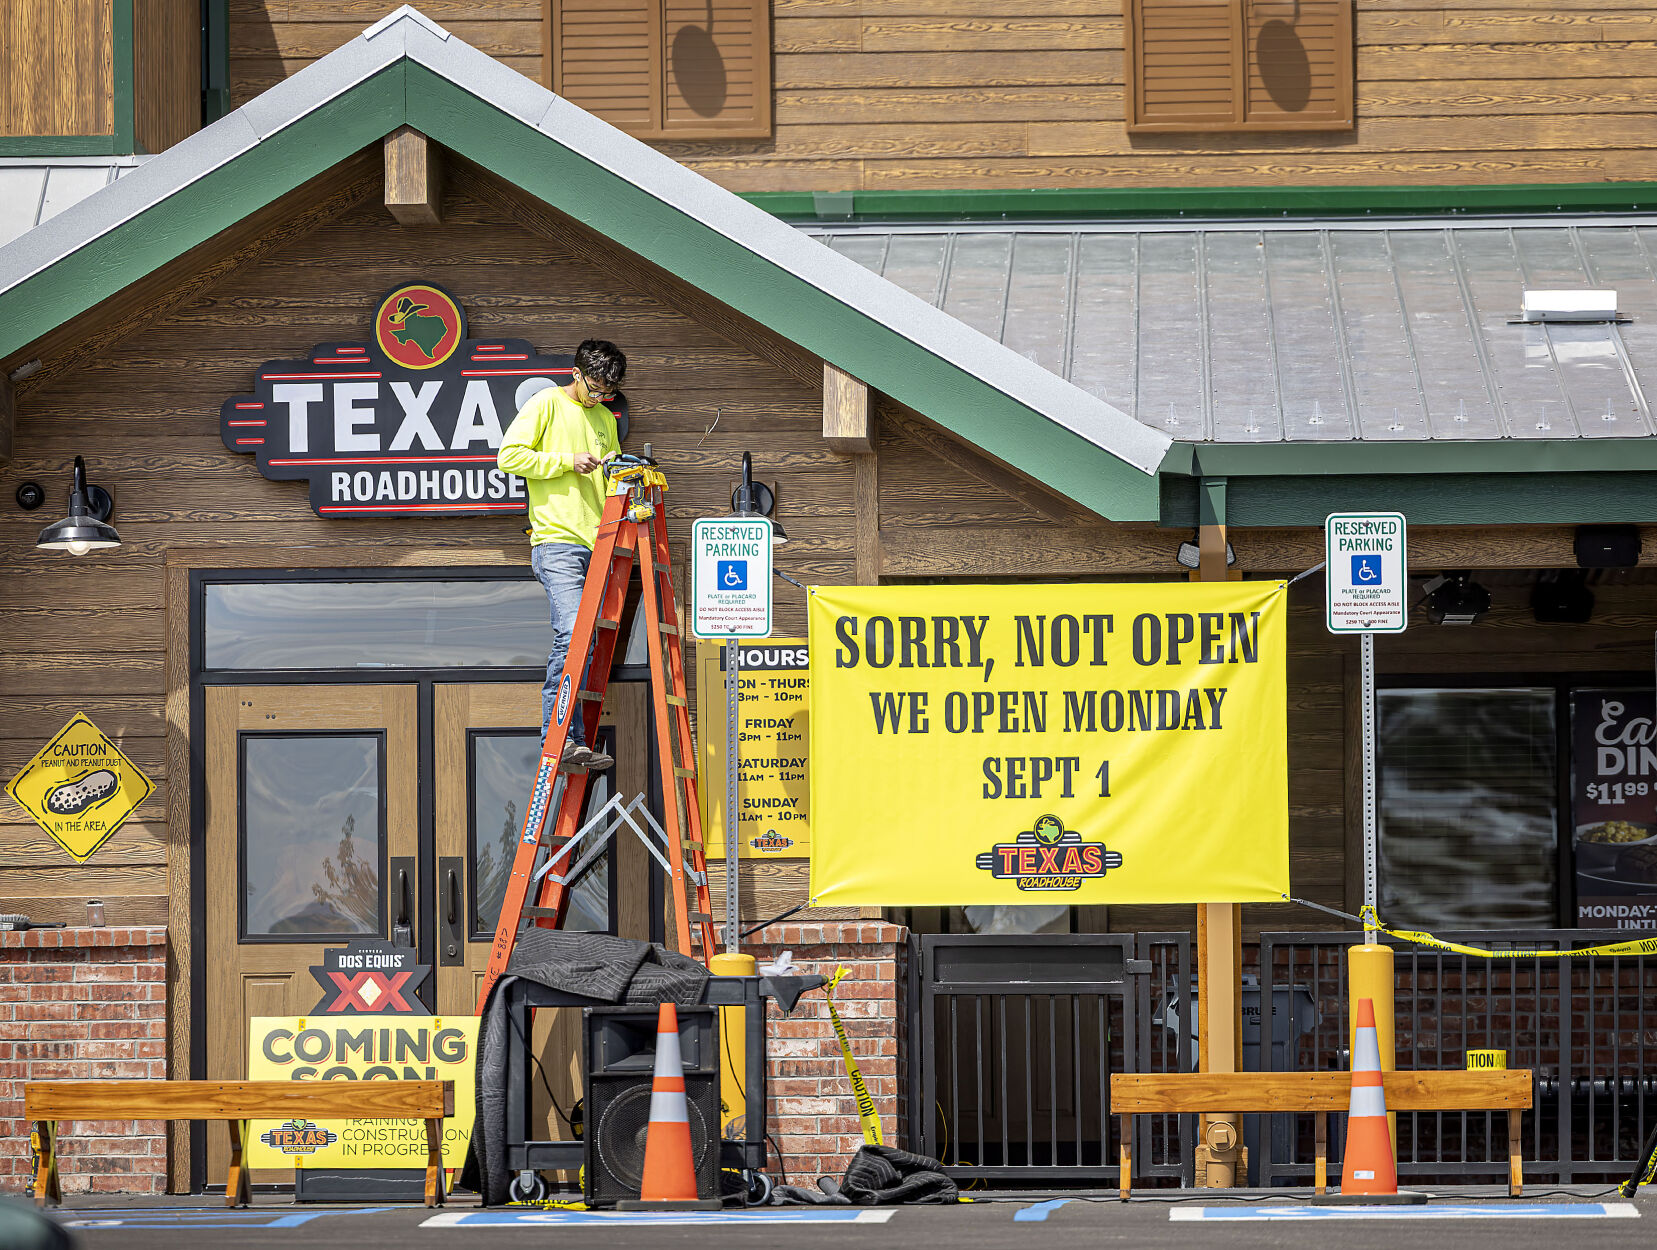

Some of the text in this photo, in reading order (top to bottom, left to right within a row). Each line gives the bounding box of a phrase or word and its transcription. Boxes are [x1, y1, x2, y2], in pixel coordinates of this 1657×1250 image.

[331, 469, 525, 501] ROADHOUSE
[701, 527, 763, 540] RESERVED
[1335, 521, 1397, 535] RESERVED
[706, 543, 759, 557] PARKING
[1339, 538, 1393, 551] PARKING
[835, 611, 1260, 682] SORRY, NOT OPEN
[724, 679, 756, 689] ON
[768, 678, 809, 689] THUR
[774, 692, 802, 702] 10PM
[869, 688, 1228, 735] WE OPEN MONDAY
[745, 718, 795, 729] FRIDAY
[738, 732, 761, 741] 3PM
[776, 731, 802, 741] 11PM
[53, 743, 107, 757] CAUTION
[41, 758, 122, 768] PEANUT AND PEANUT DUST
[779, 771, 805, 781] 11PM
[982, 756, 1112, 800] SEPT 1
[743, 797, 799, 809] SUNDAY
[55, 821, 107, 832] IN THE AREA
[756, 838, 788, 848] TEXAS
[998, 846, 1103, 875] TEXAS
[1018, 877, 1081, 888] ROADHOUSE
[1579, 905, 1657, 918] MONDAY-
[338, 954, 402, 969] DOS EQUIS
[326, 971, 414, 1012] XX
[1242, 1006, 1276, 1016] RUE
[262, 1028, 468, 1064] COMING
[850, 1069, 876, 1118] CAUTION
[272, 1130, 327, 1146] TEXAS
[342, 1128, 469, 1141] CONSTRUCON
[342, 1143, 450, 1156] IN PROGRES
